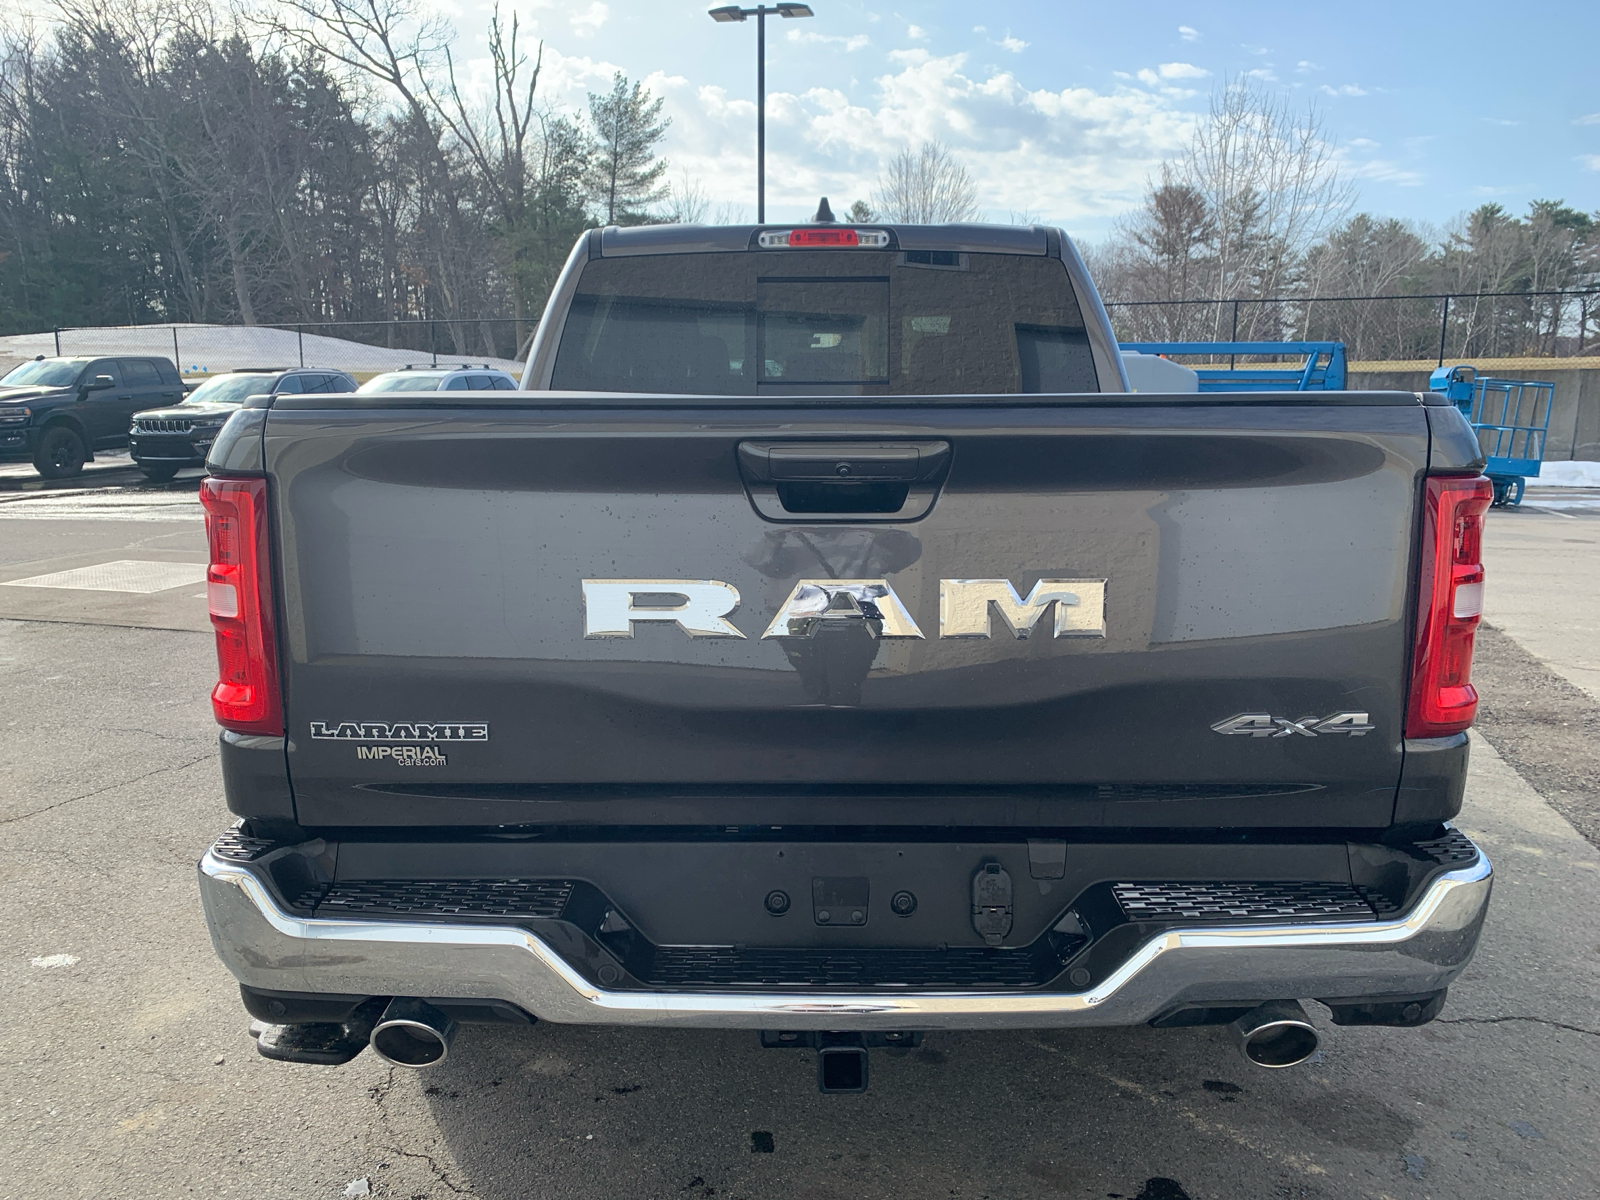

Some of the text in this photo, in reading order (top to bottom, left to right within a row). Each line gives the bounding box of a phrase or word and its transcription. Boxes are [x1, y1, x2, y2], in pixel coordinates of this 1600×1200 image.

[581, 578, 1108, 639] RAM
[310, 721, 489, 741] LARAMIE
[1210, 711, 1375, 737] 4x4
[357, 746, 446, 759] IMPERIAL
[398, 757, 447, 766] cars.com
